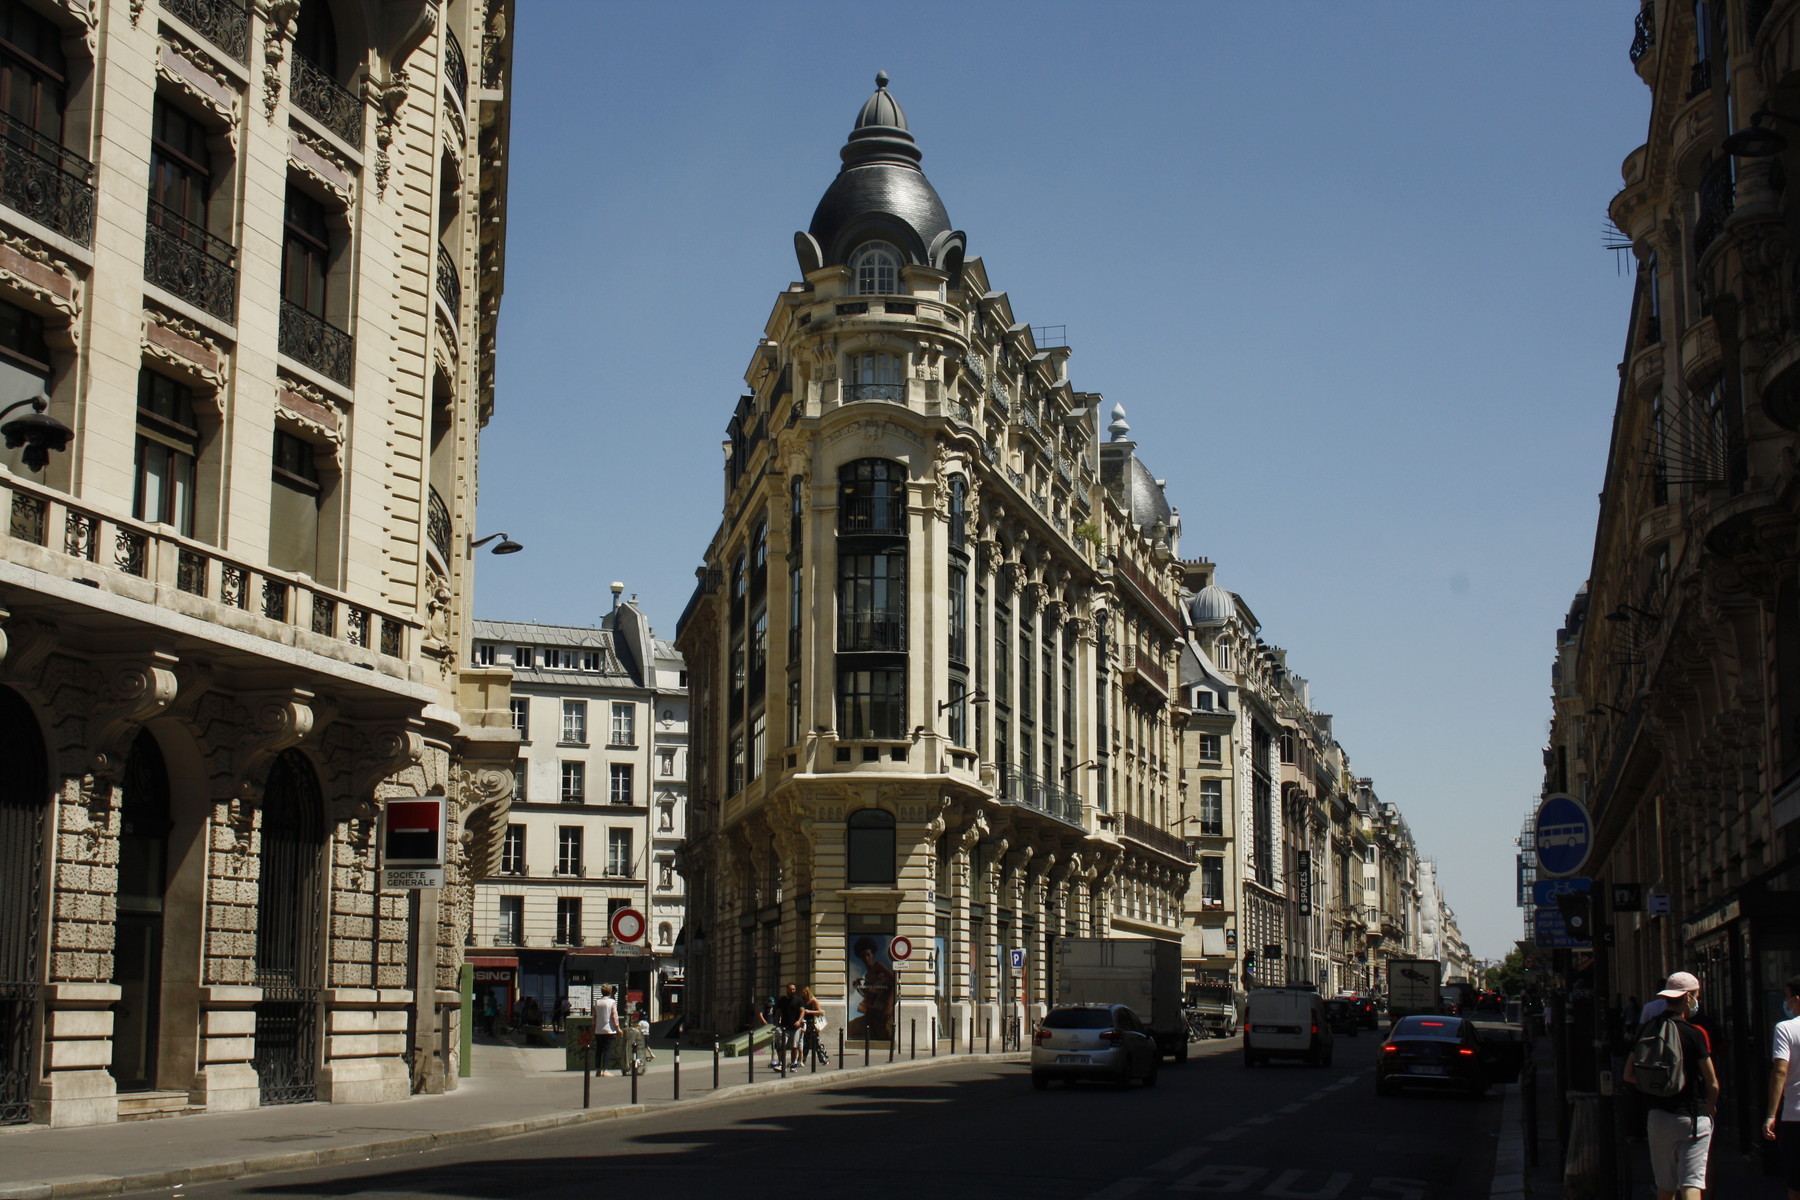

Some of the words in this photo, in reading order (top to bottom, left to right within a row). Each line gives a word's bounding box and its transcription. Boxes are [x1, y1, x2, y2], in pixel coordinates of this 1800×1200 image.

[387, 871, 426, 879] SOCIETE
[387, 879, 436, 887] GENERALE
[1013, 953, 1020, 965] P
[473, 971, 511, 981] SING
